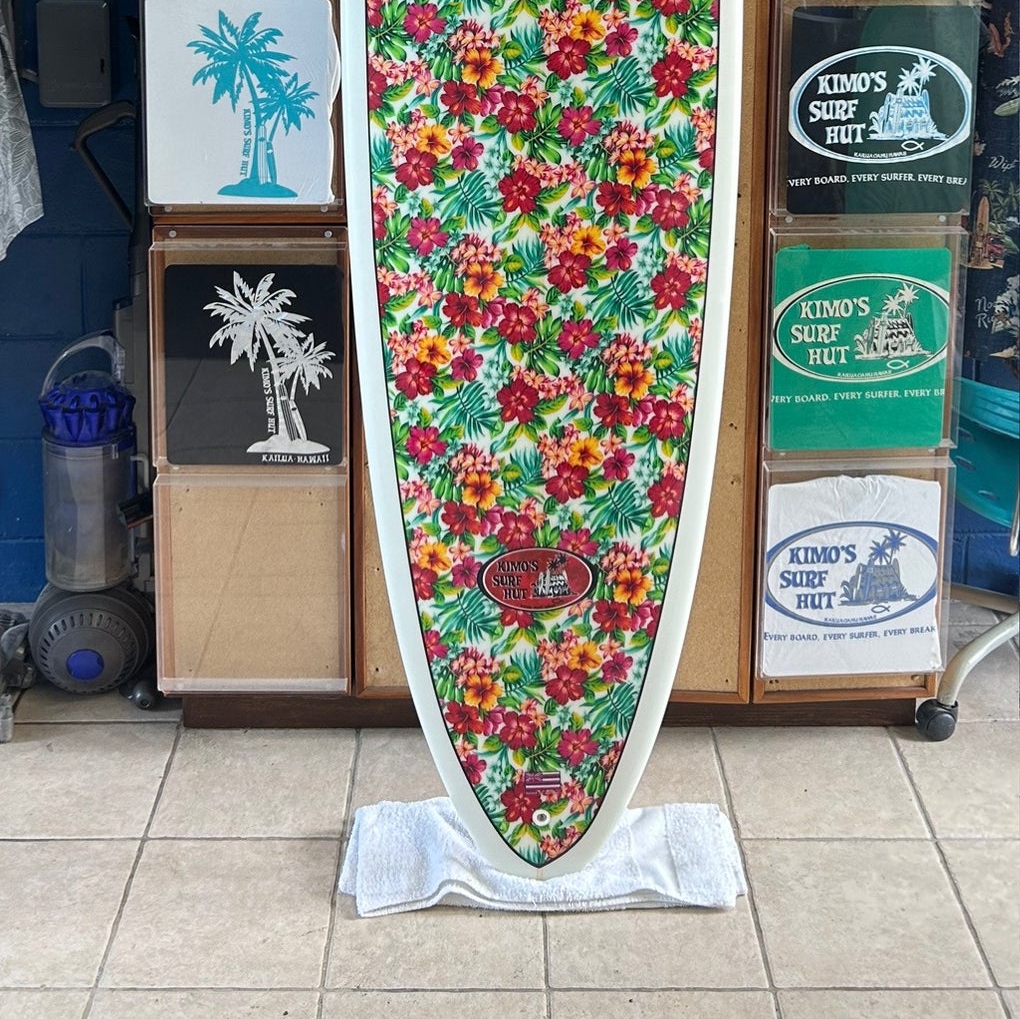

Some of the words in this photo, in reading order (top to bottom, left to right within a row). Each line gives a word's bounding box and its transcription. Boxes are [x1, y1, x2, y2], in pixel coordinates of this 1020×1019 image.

[817, 71, 887, 94] KIMO'S
[808, 100, 859, 123] SURF
[825, 124, 866, 144] HUT
[242, 138, 252, 157] SURF
[240, 161, 248, 176] HUT
[787, 178, 812, 187] VERY
[815, 175, 849, 185] BOARD.
[852, 174, 879, 182] EVERY
[881, 173, 915, 182] SURFER.
[918, 174, 944, 183] EVERY
[800, 297, 870, 319] KIMO'S
[791, 324, 841, 344] SURF
[808, 346, 849, 365] HUT
[795, 394, 831, 403] BOARD.
[834, 392, 862, 400] EVERY
[865, 390, 901, 398] SURFER.
[904, 389, 932, 397] EVERY
[266, 396, 274, 416] SURF
[298, 454, 329, 463] HAWAII
[788, 544, 857, 565] KIMO'S
[497, 561, 538, 572] KIMO'S
[492, 575, 522, 587] SURF
[779, 571, 828, 589] SURF
[503, 589, 527, 600] HUT
[796, 592, 836, 609] HUT
[884, 629, 908, 637] EVERY
